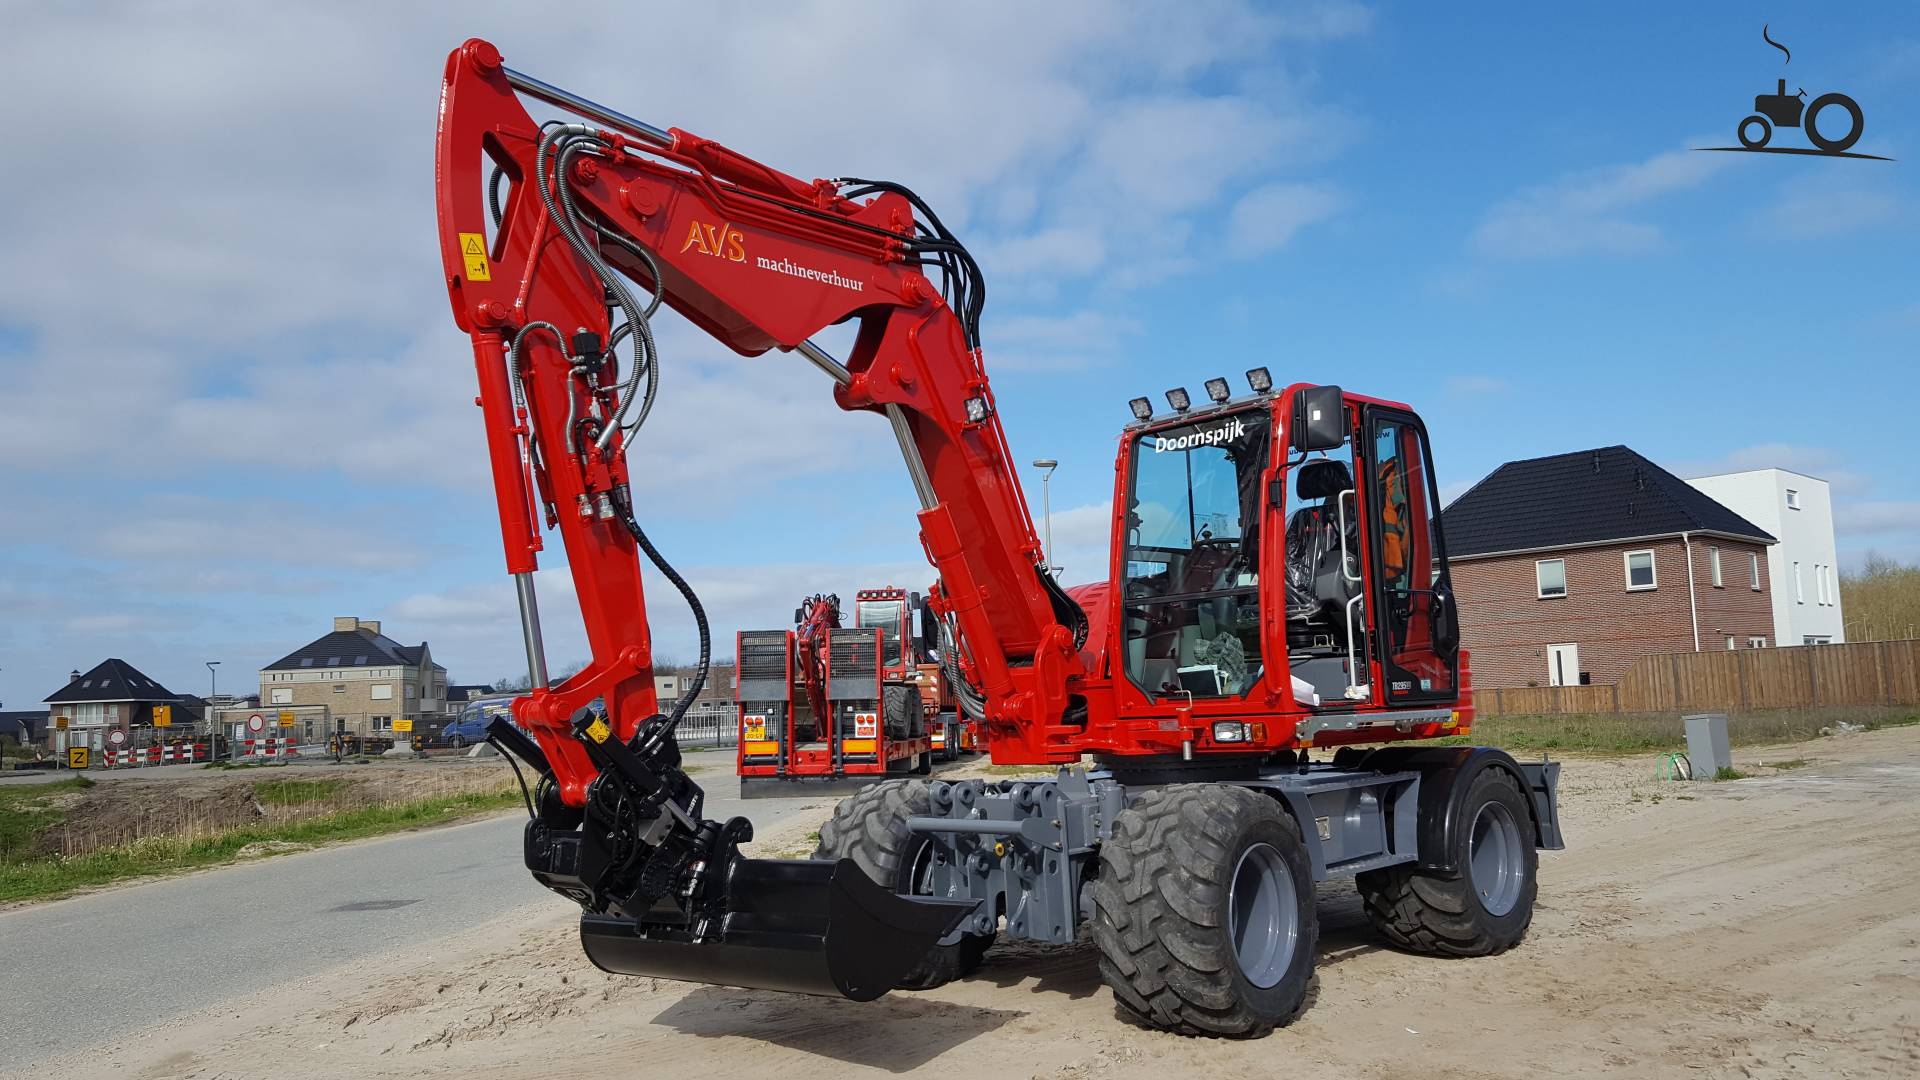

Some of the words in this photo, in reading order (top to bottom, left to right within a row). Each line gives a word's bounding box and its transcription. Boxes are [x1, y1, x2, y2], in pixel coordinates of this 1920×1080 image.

[757, 256, 863, 291] machineverhuur
[1155, 420, 1245, 453] Doornspijk
[74, 752, 84, 763] Z
